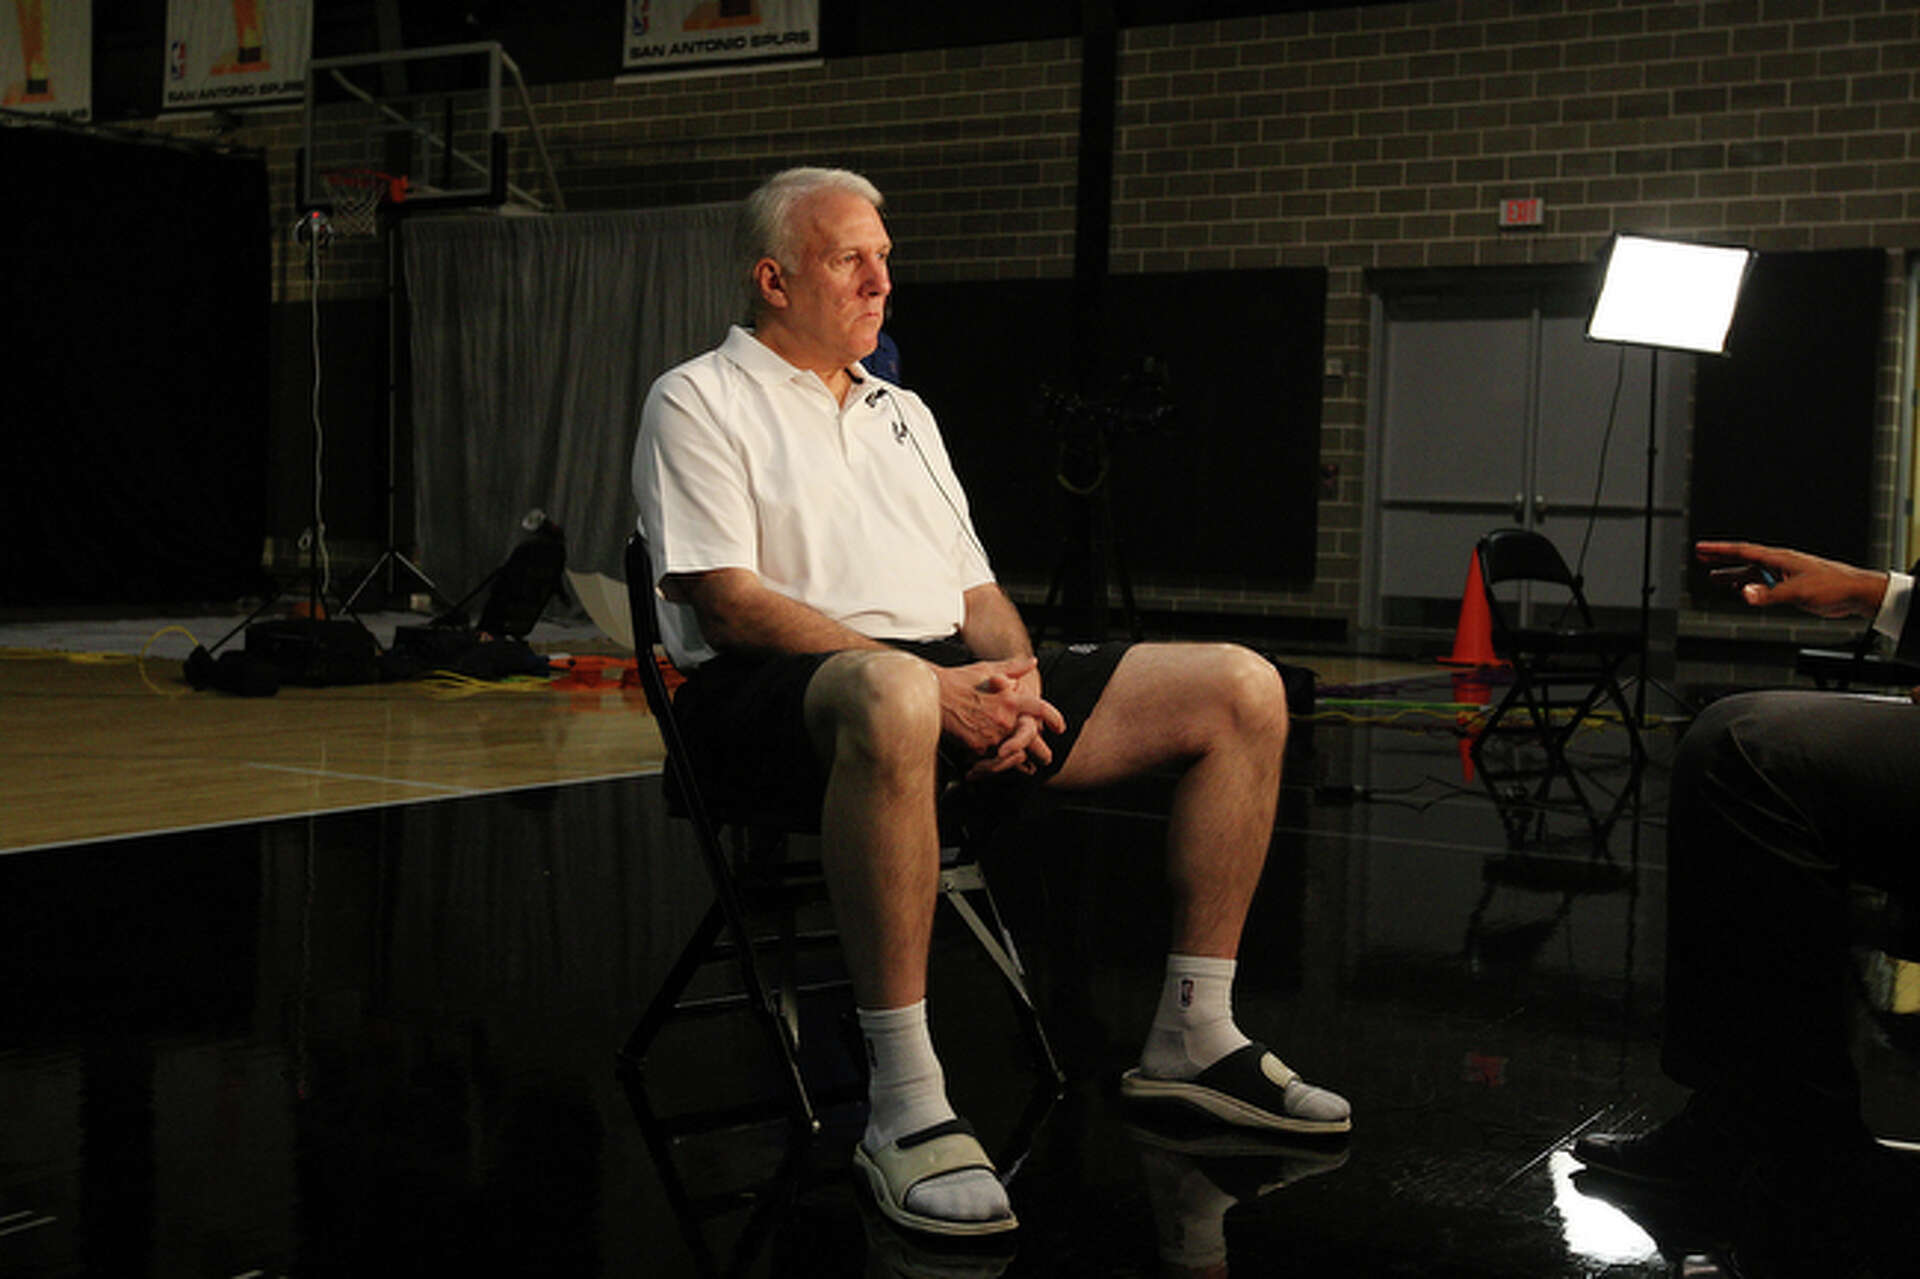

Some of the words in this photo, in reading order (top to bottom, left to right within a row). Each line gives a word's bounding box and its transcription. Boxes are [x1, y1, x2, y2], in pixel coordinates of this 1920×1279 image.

[630, 45, 665, 59] SAN
[669, 36, 746, 56] ANTONIO
[751, 30, 810, 47] SPURS
[168, 90, 195, 104] SAN
[199, 84, 256, 98] ANTONIO
[1506, 199, 1537, 223] EXIT
